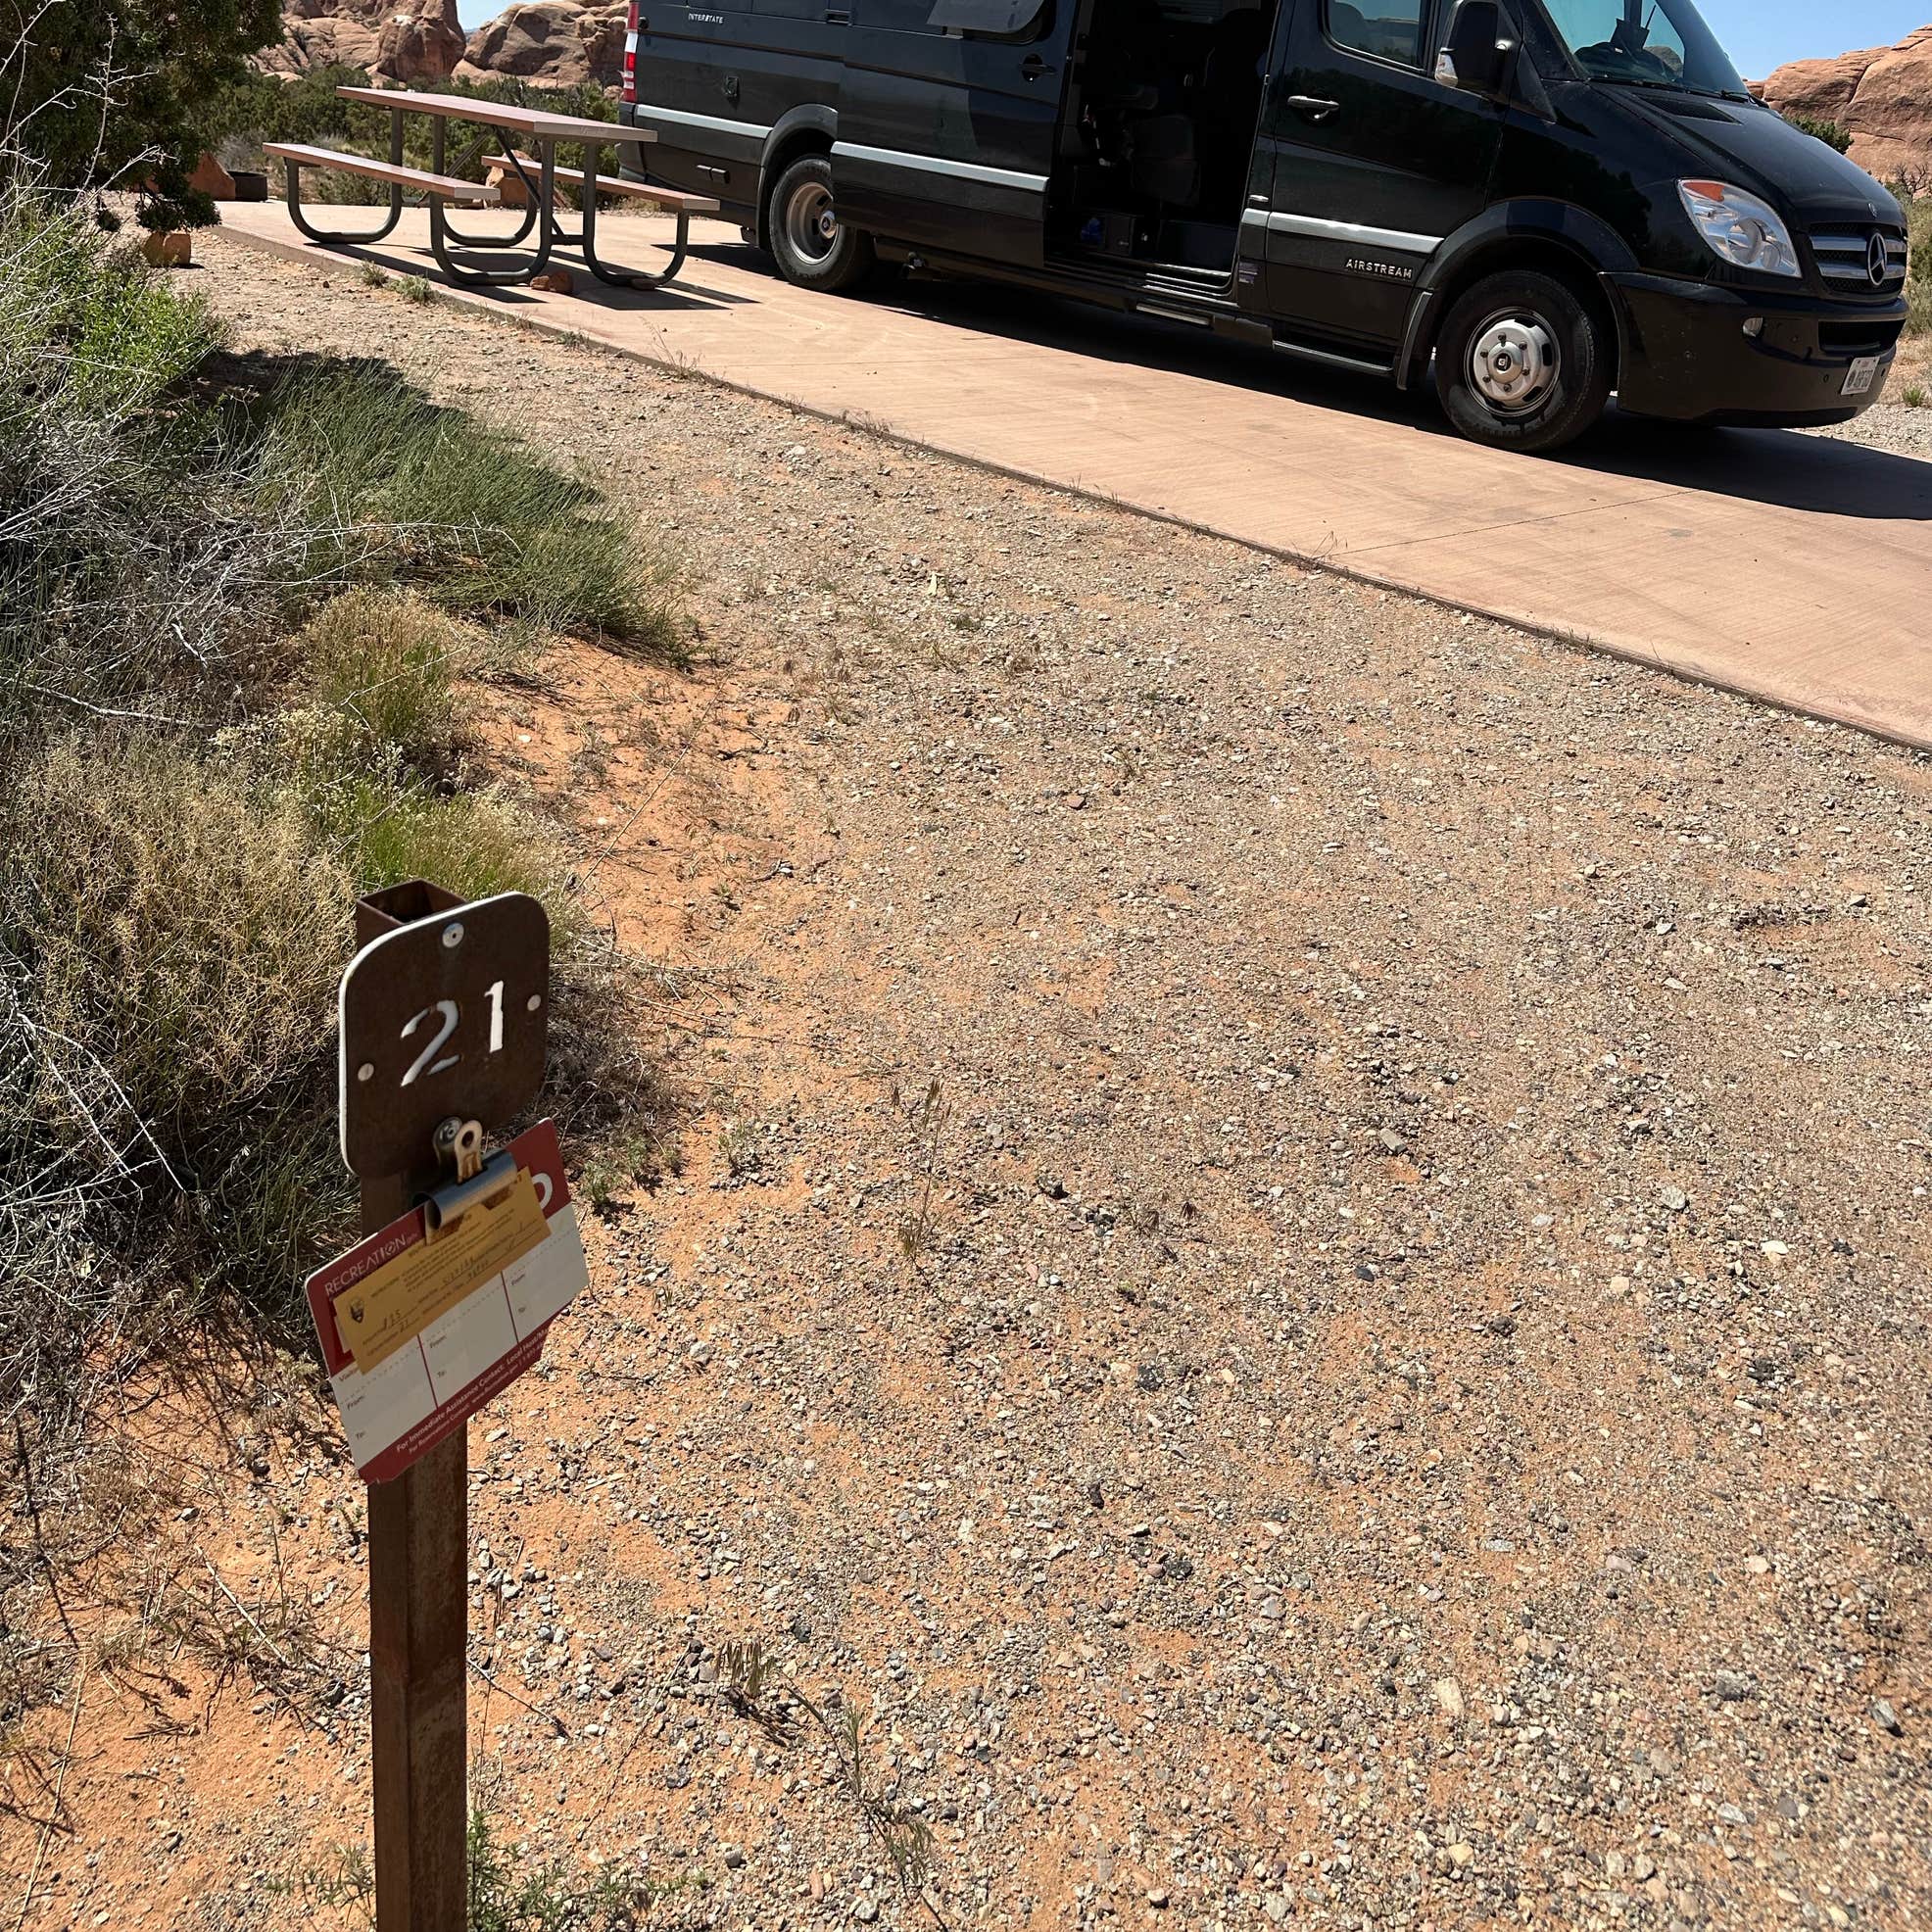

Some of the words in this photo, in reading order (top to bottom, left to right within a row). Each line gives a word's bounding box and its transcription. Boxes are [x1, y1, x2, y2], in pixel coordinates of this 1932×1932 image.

[688, 13, 724, 24] INTERSTATE
[1346, 259, 1412, 278] AIRSTREAM
[400, 980, 504, 1087] 21
[397, 1438, 407, 1452] For
[410, 1410, 444, 1442] Immediate
[447, 1384, 477, 1414] Assistance
